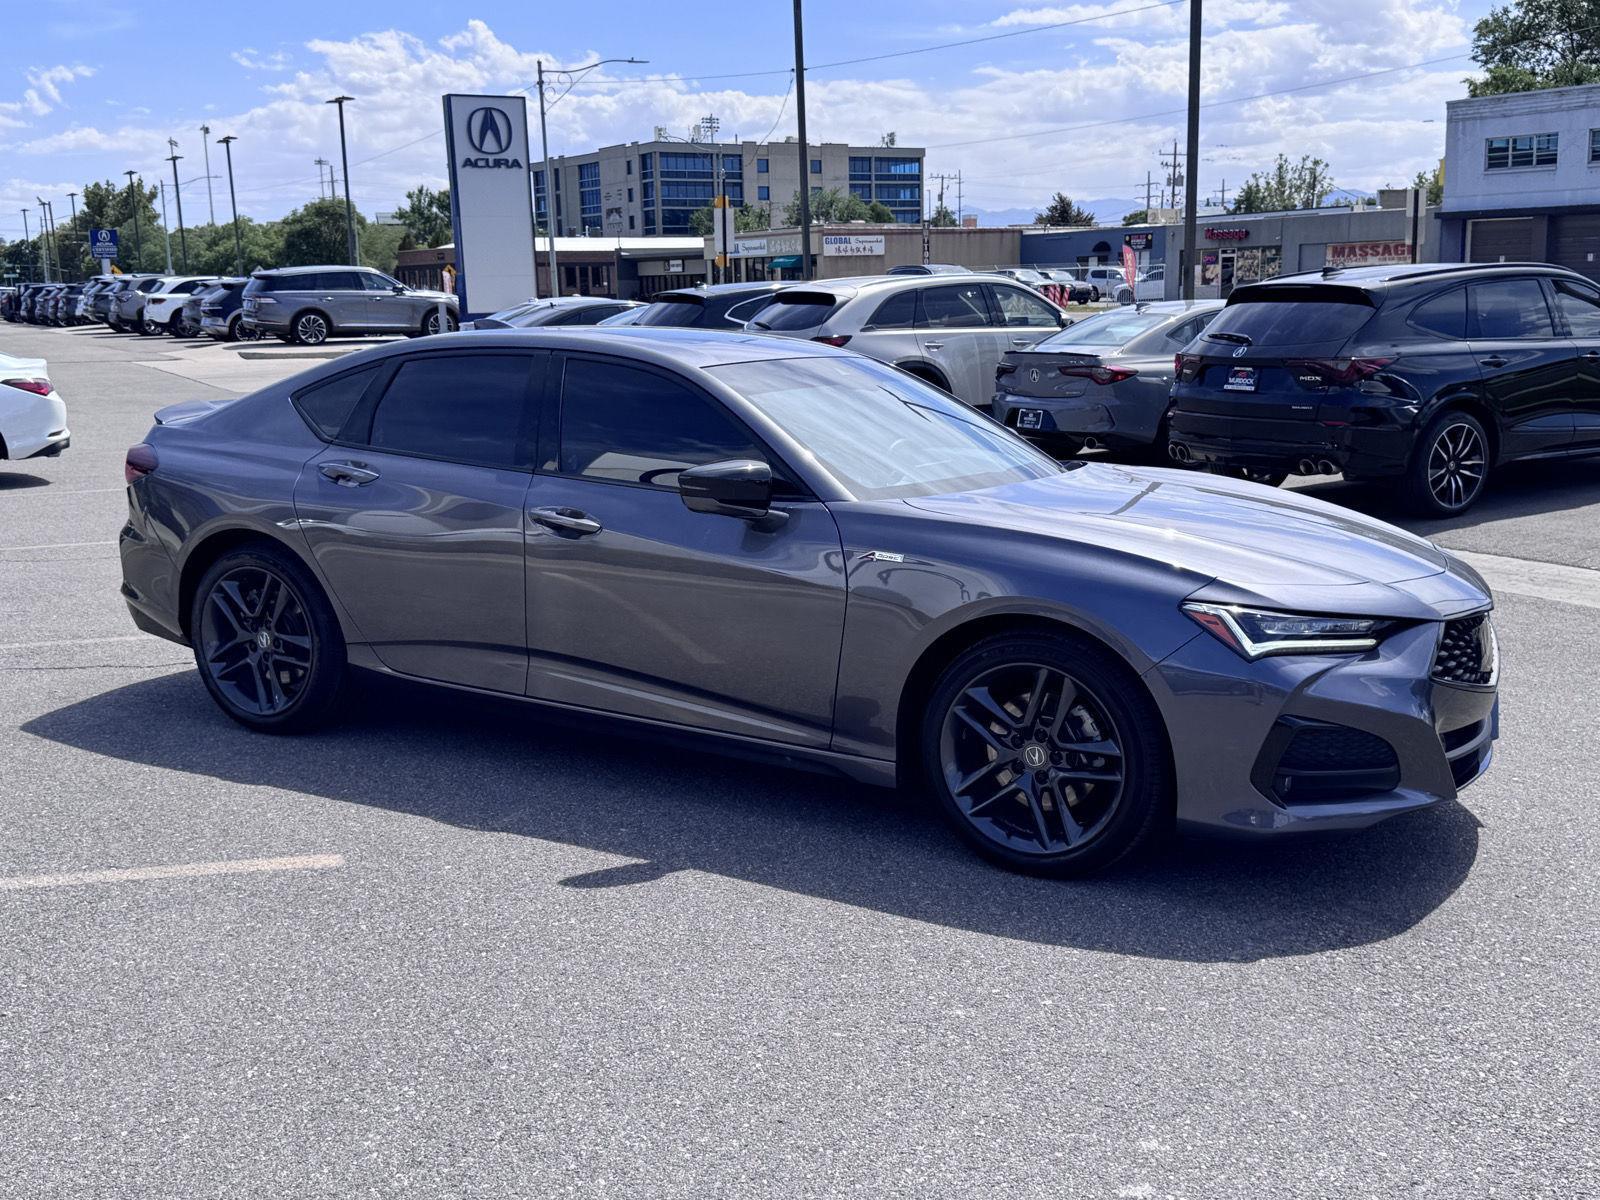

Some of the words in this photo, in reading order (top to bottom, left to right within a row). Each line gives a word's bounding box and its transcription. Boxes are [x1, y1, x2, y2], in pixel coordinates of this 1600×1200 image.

[462, 157, 523, 169] ACURA
[1204, 227, 1248, 240] Massage
[824, 236, 852, 245] GLOBAL
